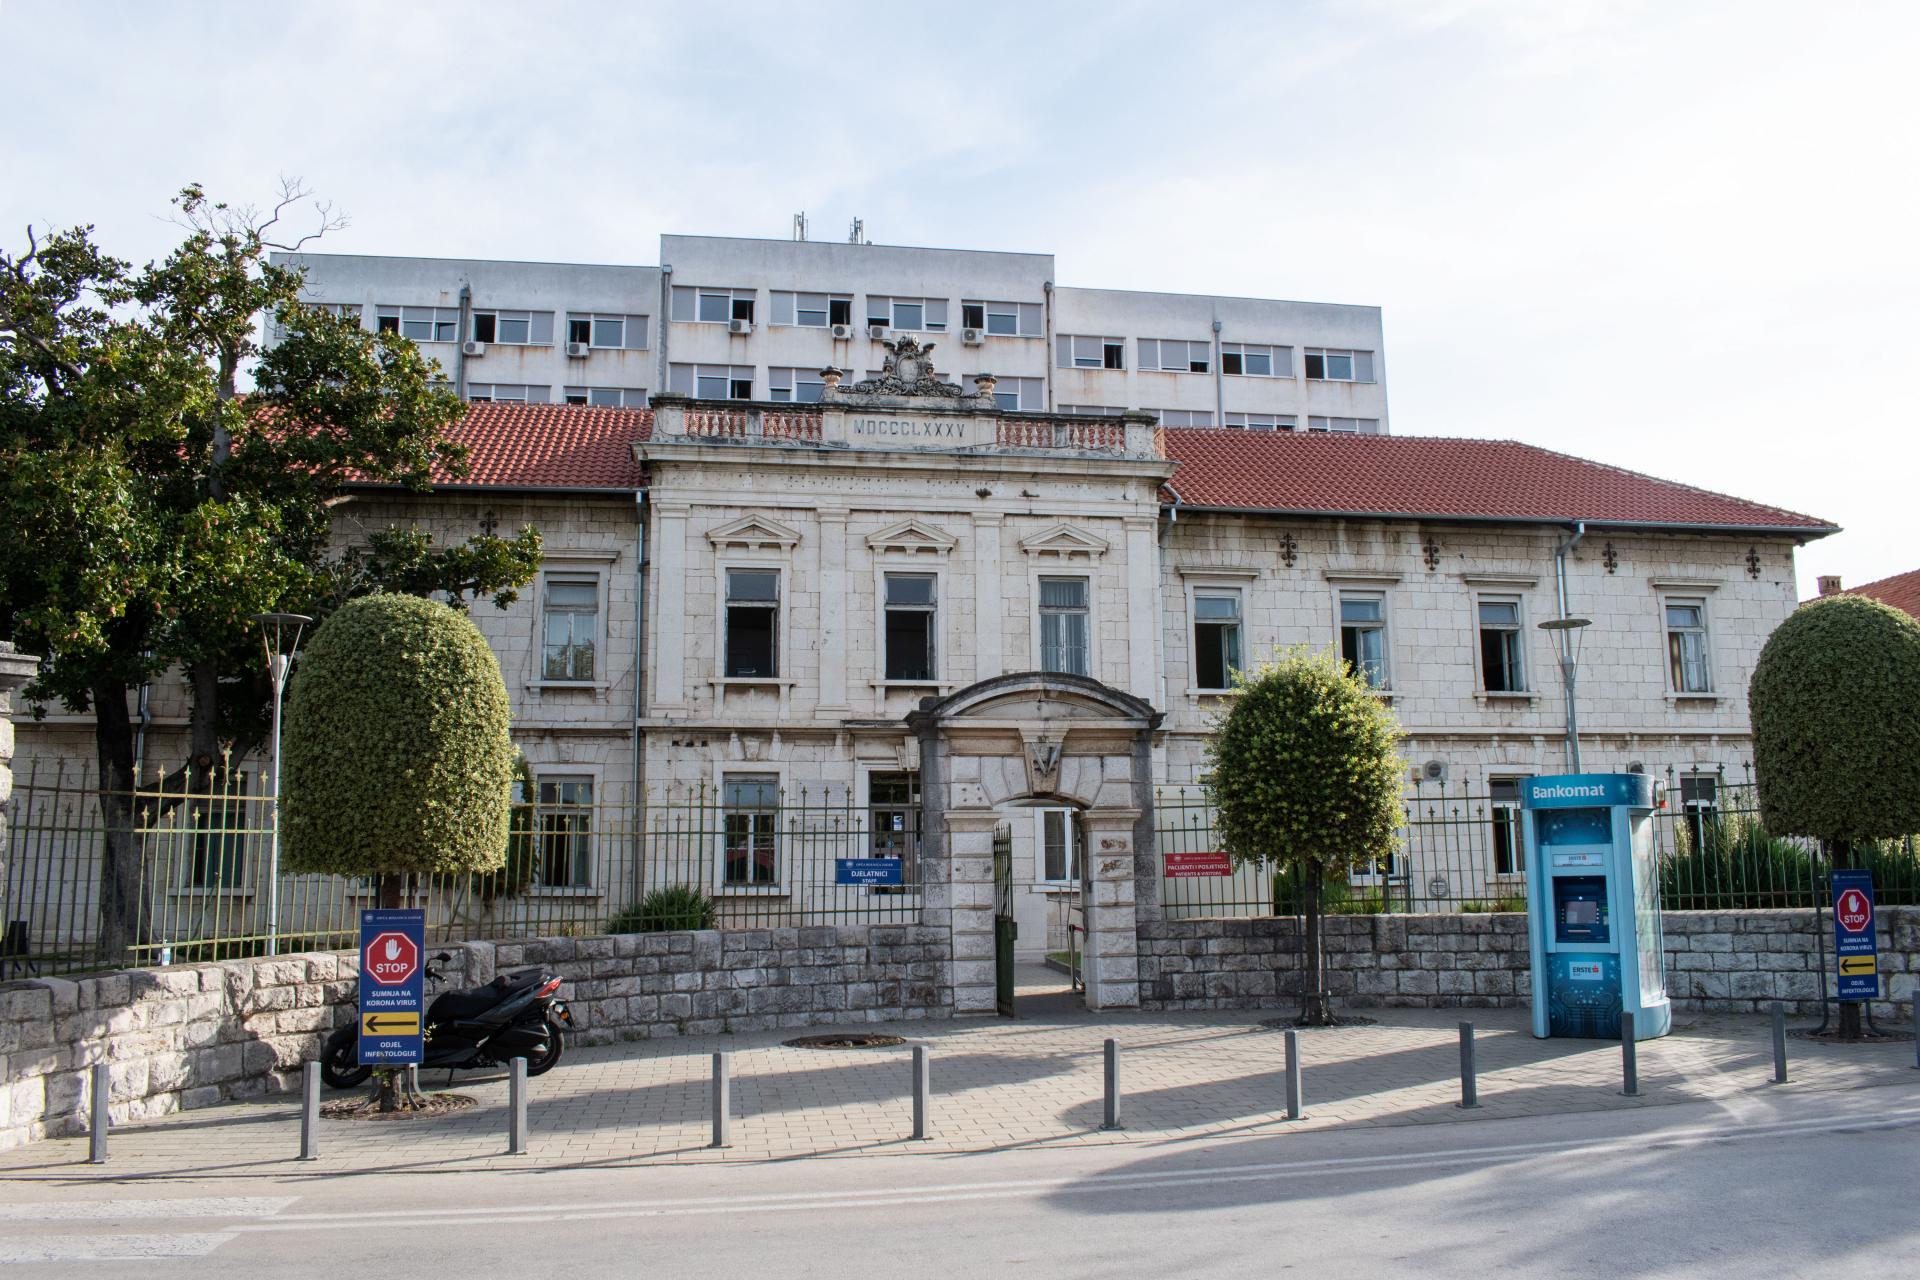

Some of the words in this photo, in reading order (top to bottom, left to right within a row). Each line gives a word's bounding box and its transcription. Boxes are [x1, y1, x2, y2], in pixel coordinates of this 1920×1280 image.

[854, 419, 965, 437] MDCCCLXXXV
[1533, 784, 1605, 799] Bankomat
[1844, 914, 1864, 923] STOP
[376, 963, 408, 973] STOP
